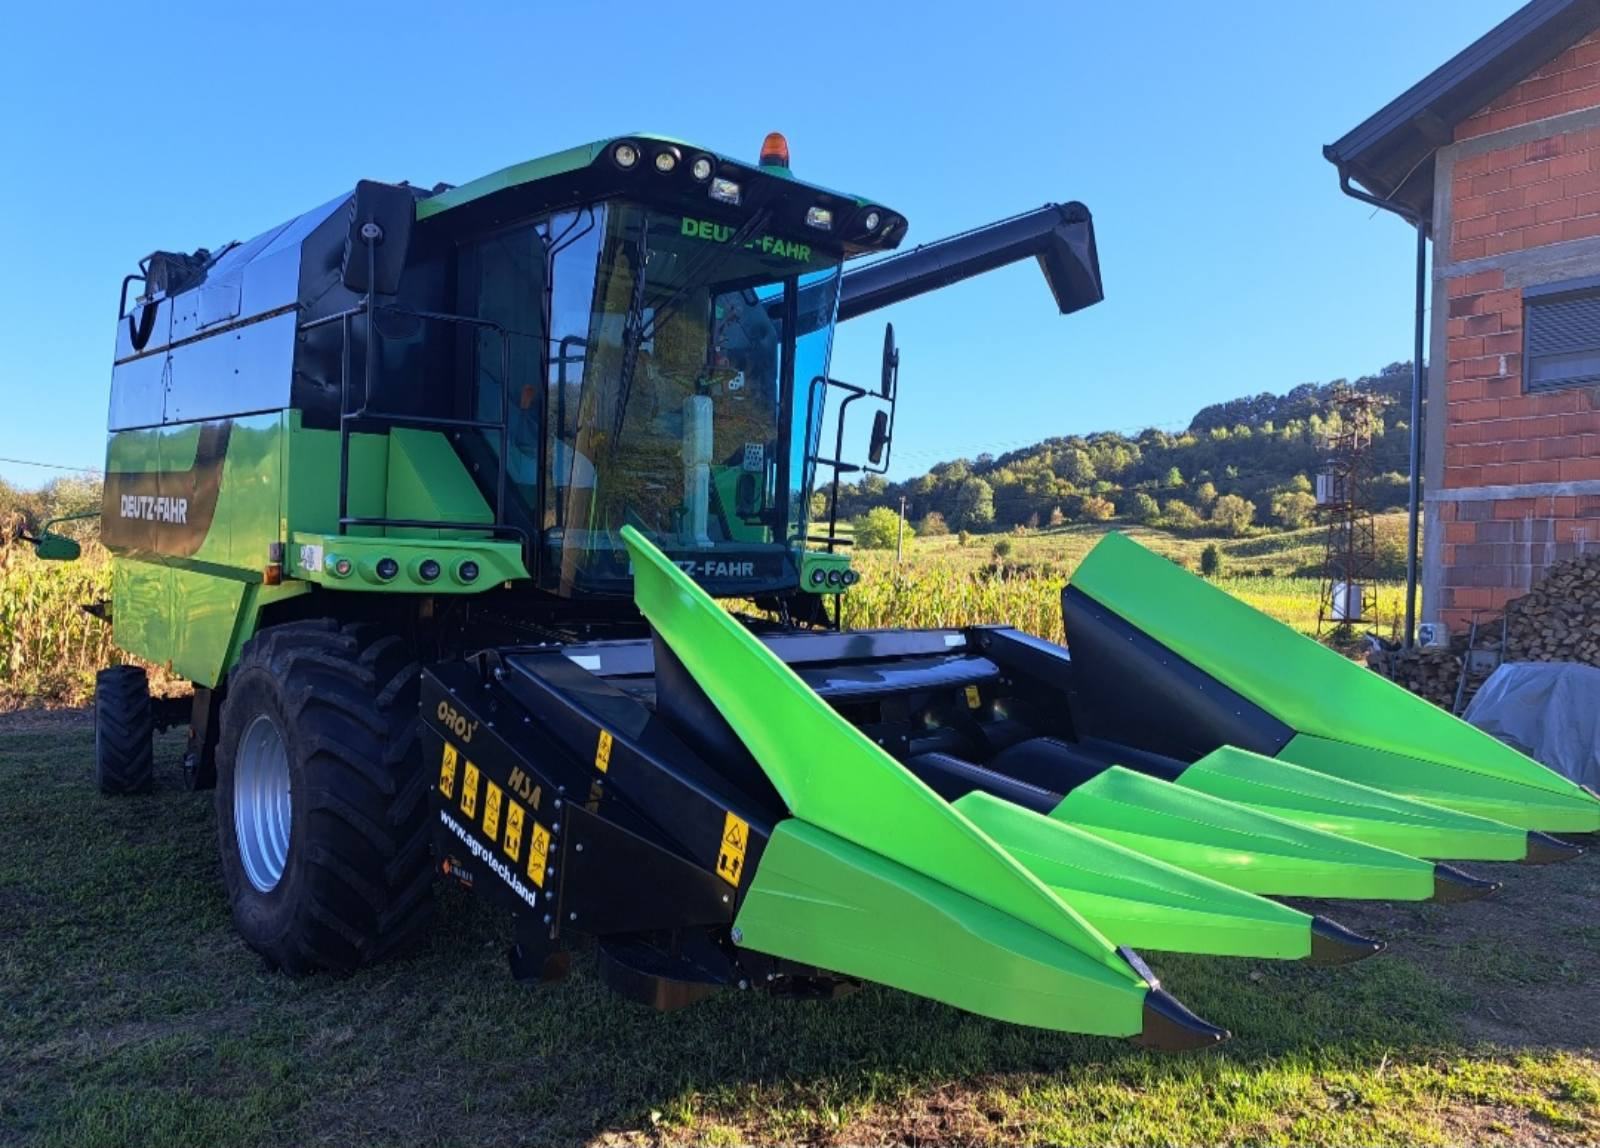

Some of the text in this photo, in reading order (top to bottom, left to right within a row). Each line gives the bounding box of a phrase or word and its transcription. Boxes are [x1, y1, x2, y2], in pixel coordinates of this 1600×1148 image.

[681, 217, 811, 262] DEU-FAHR
[120, 494, 188, 524] DEUTZ-FAHR
[628, 560, 754, 577] Z-FAHR
